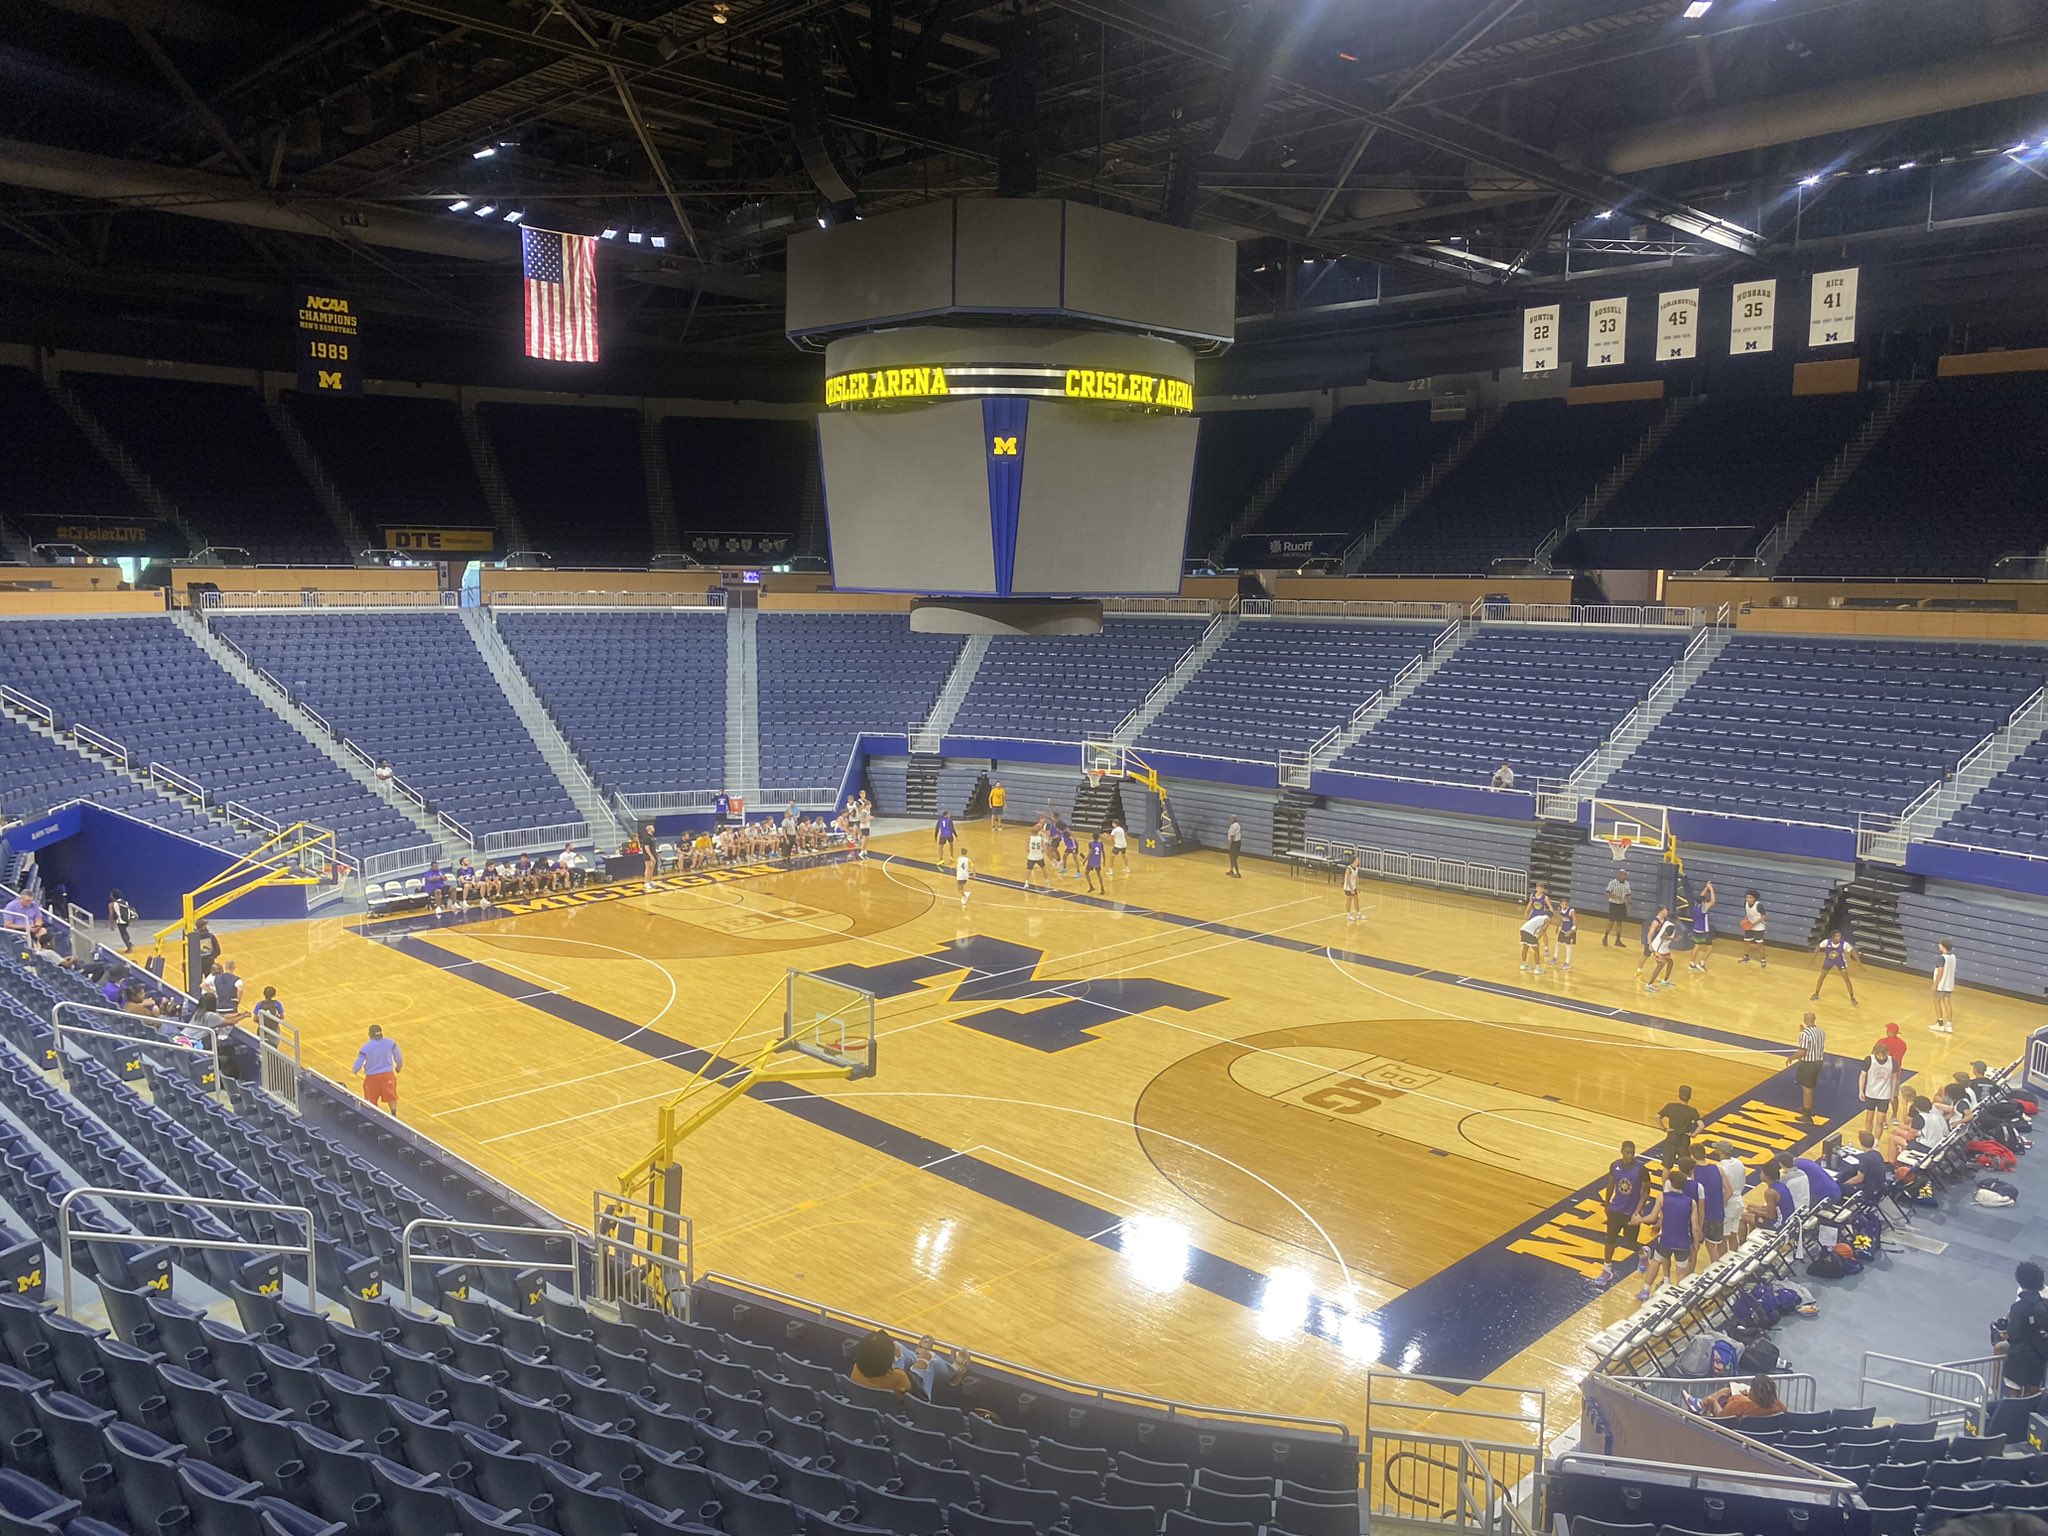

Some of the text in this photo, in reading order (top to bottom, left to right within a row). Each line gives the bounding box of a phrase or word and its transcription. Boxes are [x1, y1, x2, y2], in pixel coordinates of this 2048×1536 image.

[1826, 279, 1844, 288] RICE
[1737, 289, 1771, 302] HUBBARD
[1824, 293, 1841, 308] 41
[306, 295, 348, 313] NCAA
[1594, 306, 1621, 317] RUSSELL
[1744, 302, 1763, 318] 35
[299, 309, 357, 326] CHAMPIONS
[1529, 313, 1554, 324] BUNTIN
[1669, 311, 1687, 326] 45
[1533, 325, 1549, 340] 22
[1600, 318, 1616, 333] 33
[1825, 332, 1838, 342] M
[311, 341, 348, 361] 1989
[1670, 348, 1682, 357] M
[1745, 341, 1757, 350] M
[1535, 360, 1545, 369] M
[1600, 354, 1611, 363] M
[318, 370, 342, 390] M
[872, 367, 949, 398] ARENA
[1065, 369, 1194, 411] CRISLER ARENA
[993, 436, 1017, 455] M
[395, 532, 442, 548] DTE
[1283, 541, 1313, 551] Ruoff
[1030, 842, 1041, 850] 25
[1145, 838, 1156, 849] M
[495, 863, 787, 915] MICHIGAN
[126, 1060, 140, 1072] M
[201, 1072, 215, 1084] M
[18, 1269, 41, 1293] M
[361, 1282, 379, 1300] M
